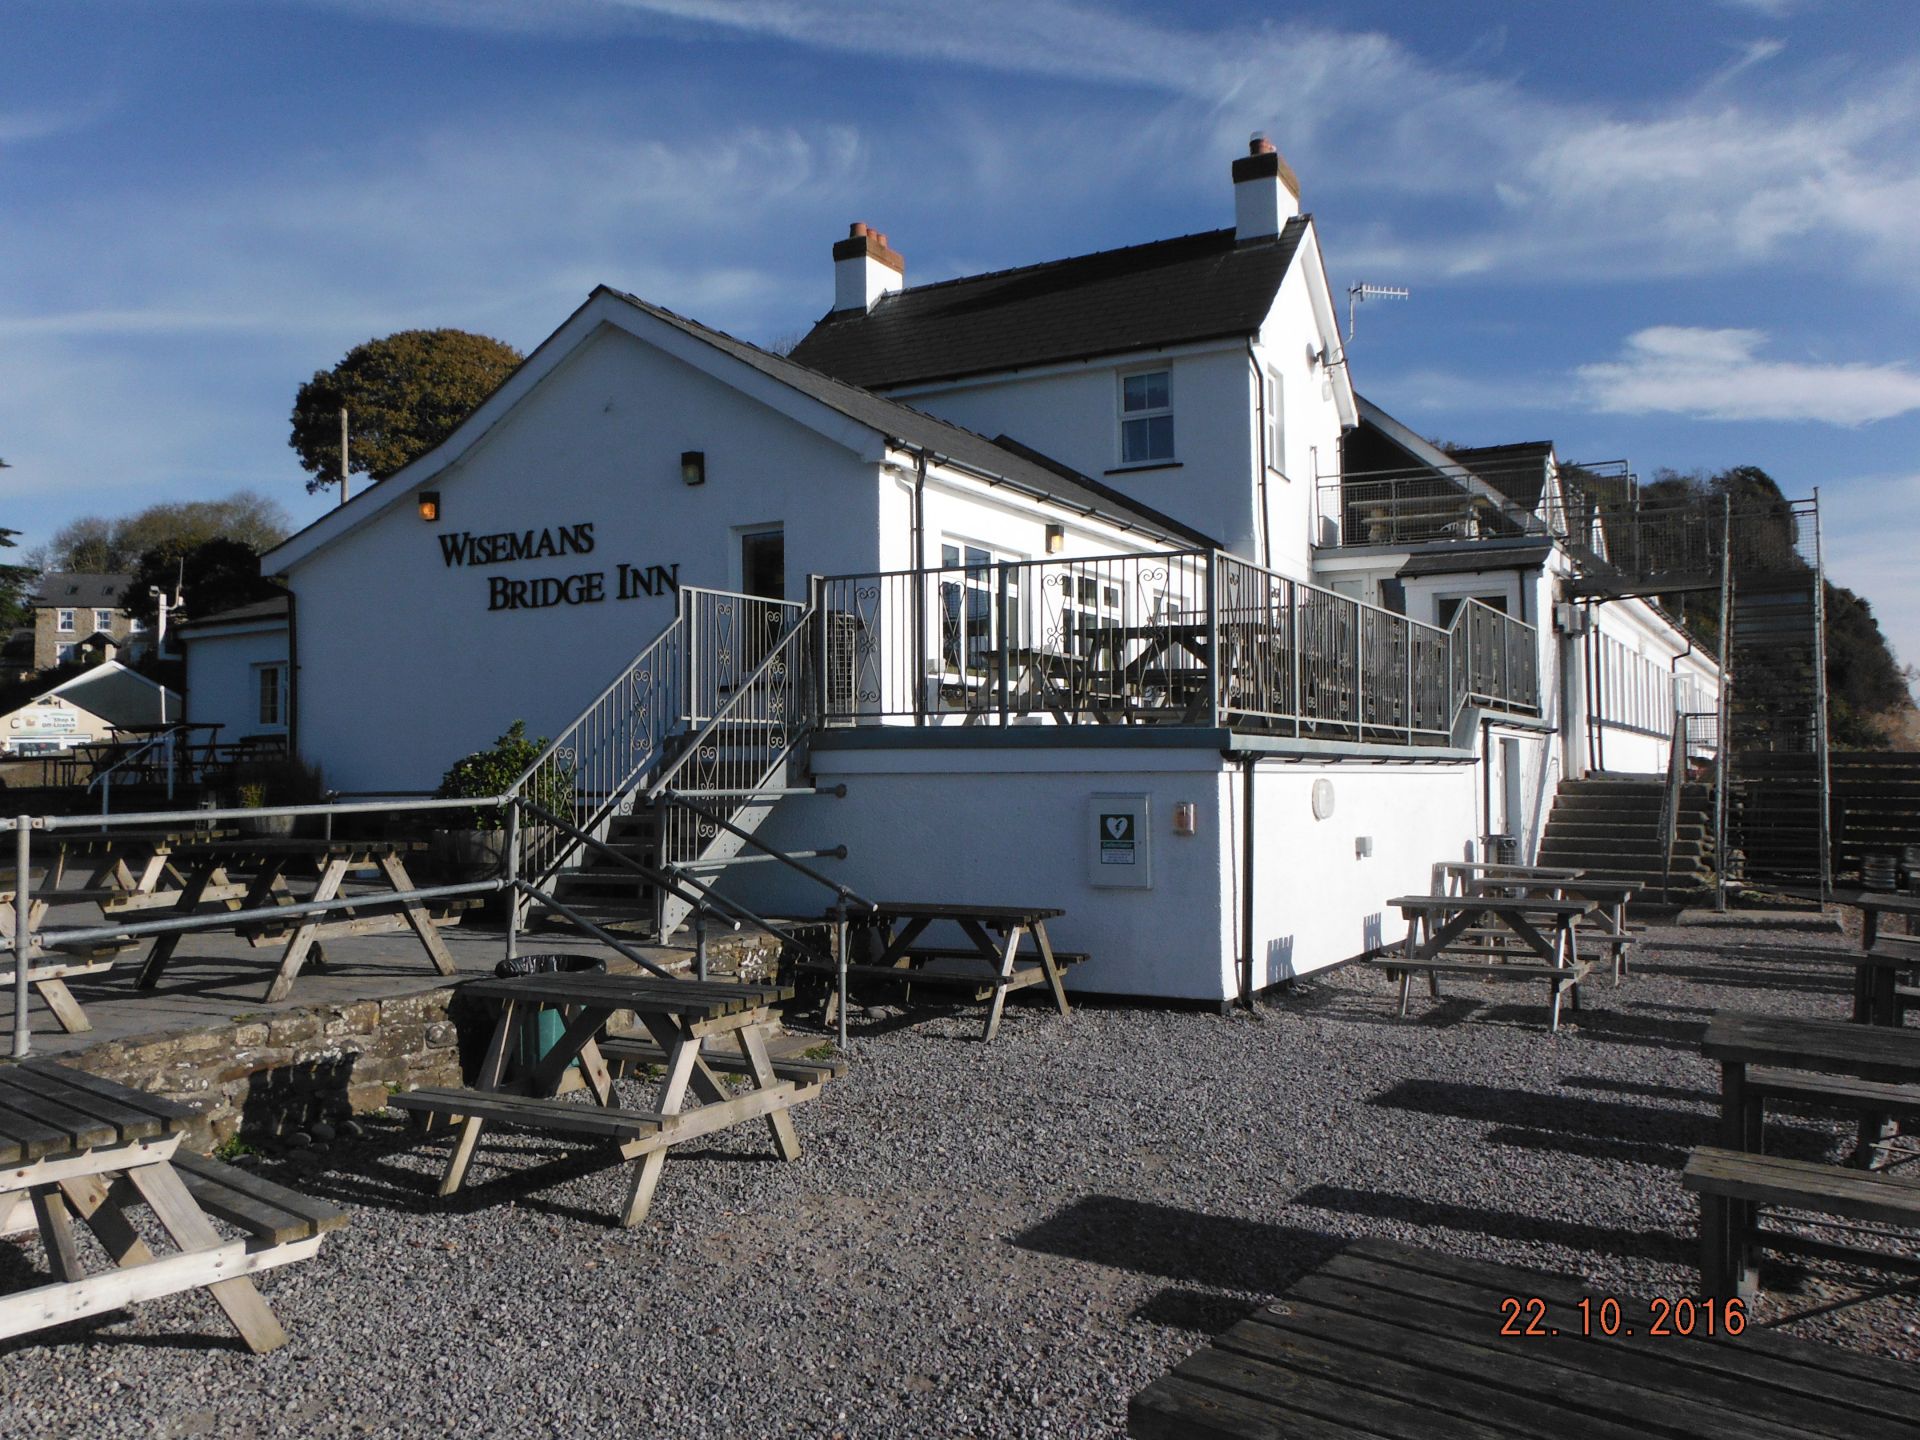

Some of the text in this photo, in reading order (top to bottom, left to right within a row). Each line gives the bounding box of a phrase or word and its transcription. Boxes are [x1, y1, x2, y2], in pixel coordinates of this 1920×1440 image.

[438, 522, 595, 568] WISEMANS
[487, 563, 680, 611] BRIDGE INN
